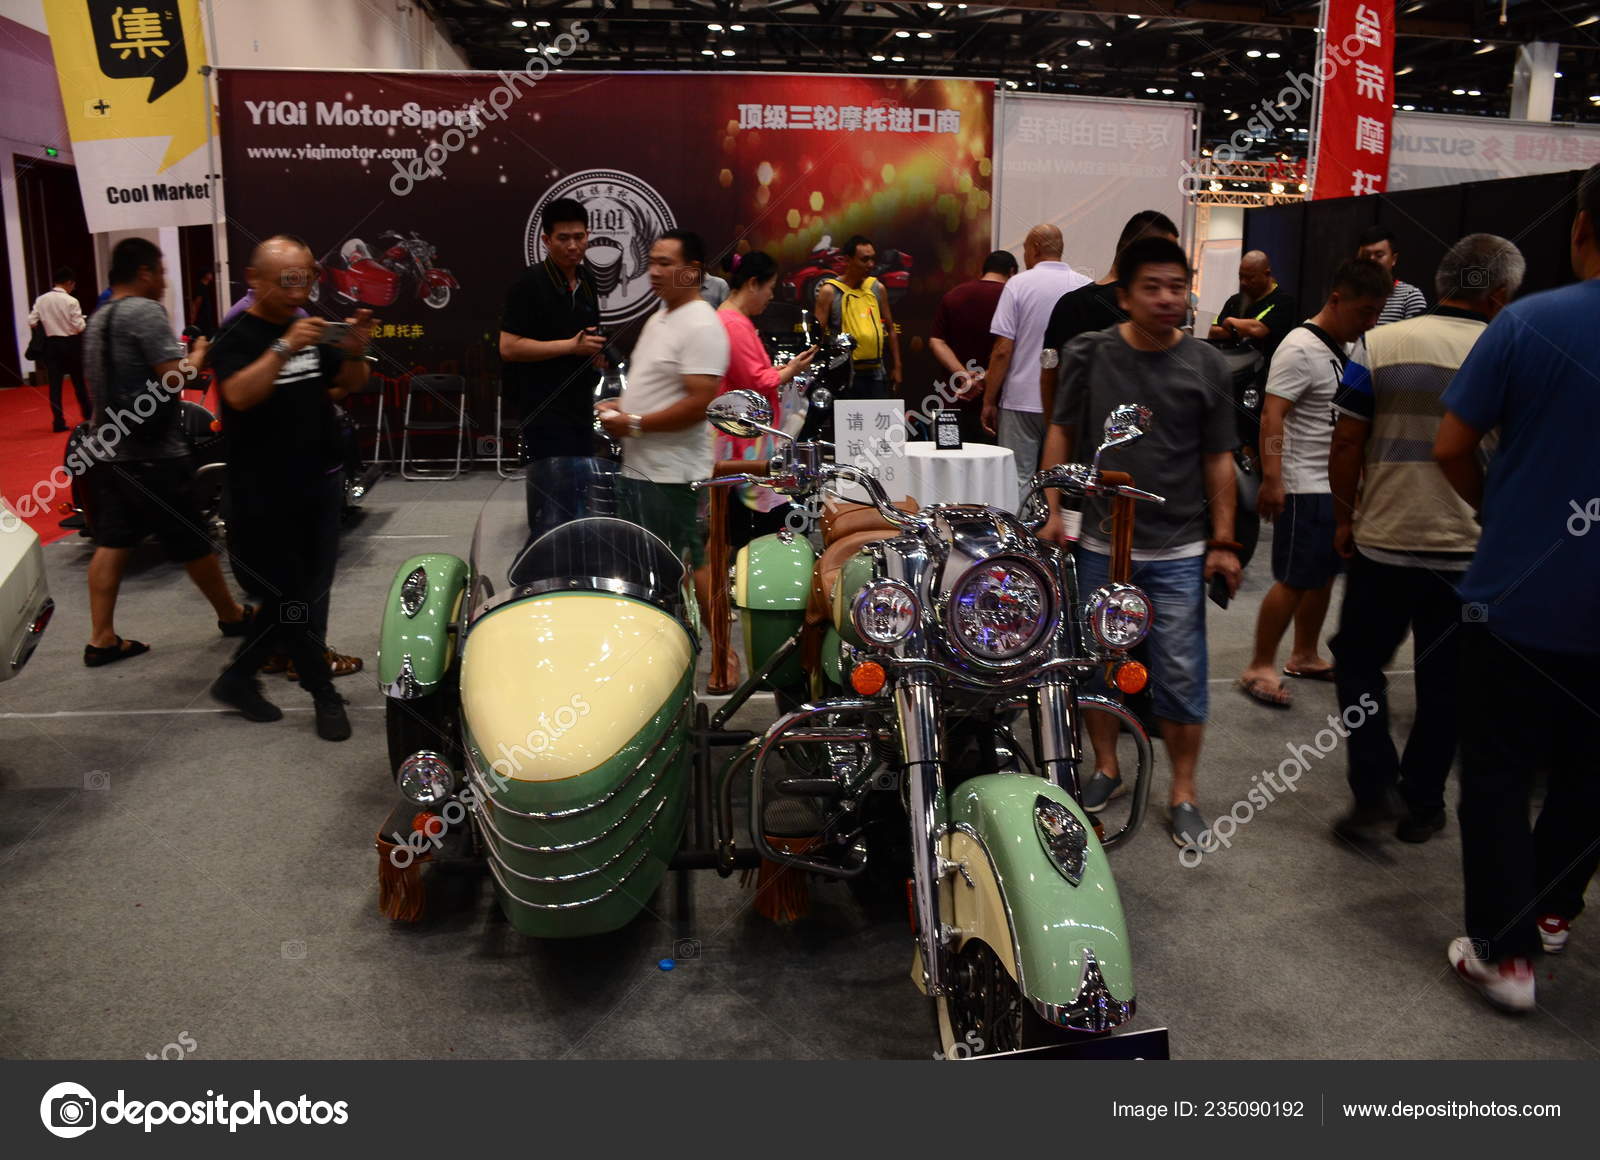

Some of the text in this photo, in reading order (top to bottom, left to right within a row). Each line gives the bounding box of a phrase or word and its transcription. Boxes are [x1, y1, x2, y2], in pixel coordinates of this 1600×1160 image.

[110, 6, 170, 60] 集
[245, 101, 481, 129] YiQi MotorSport
[738, 104, 961, 134] 顶级三轮摩托进口商
[247, 145, 418, 160] www.yiqimotor.com
[106, 182, 210, 205] Cool Market
[847, 411, 891, 432] 请勿
